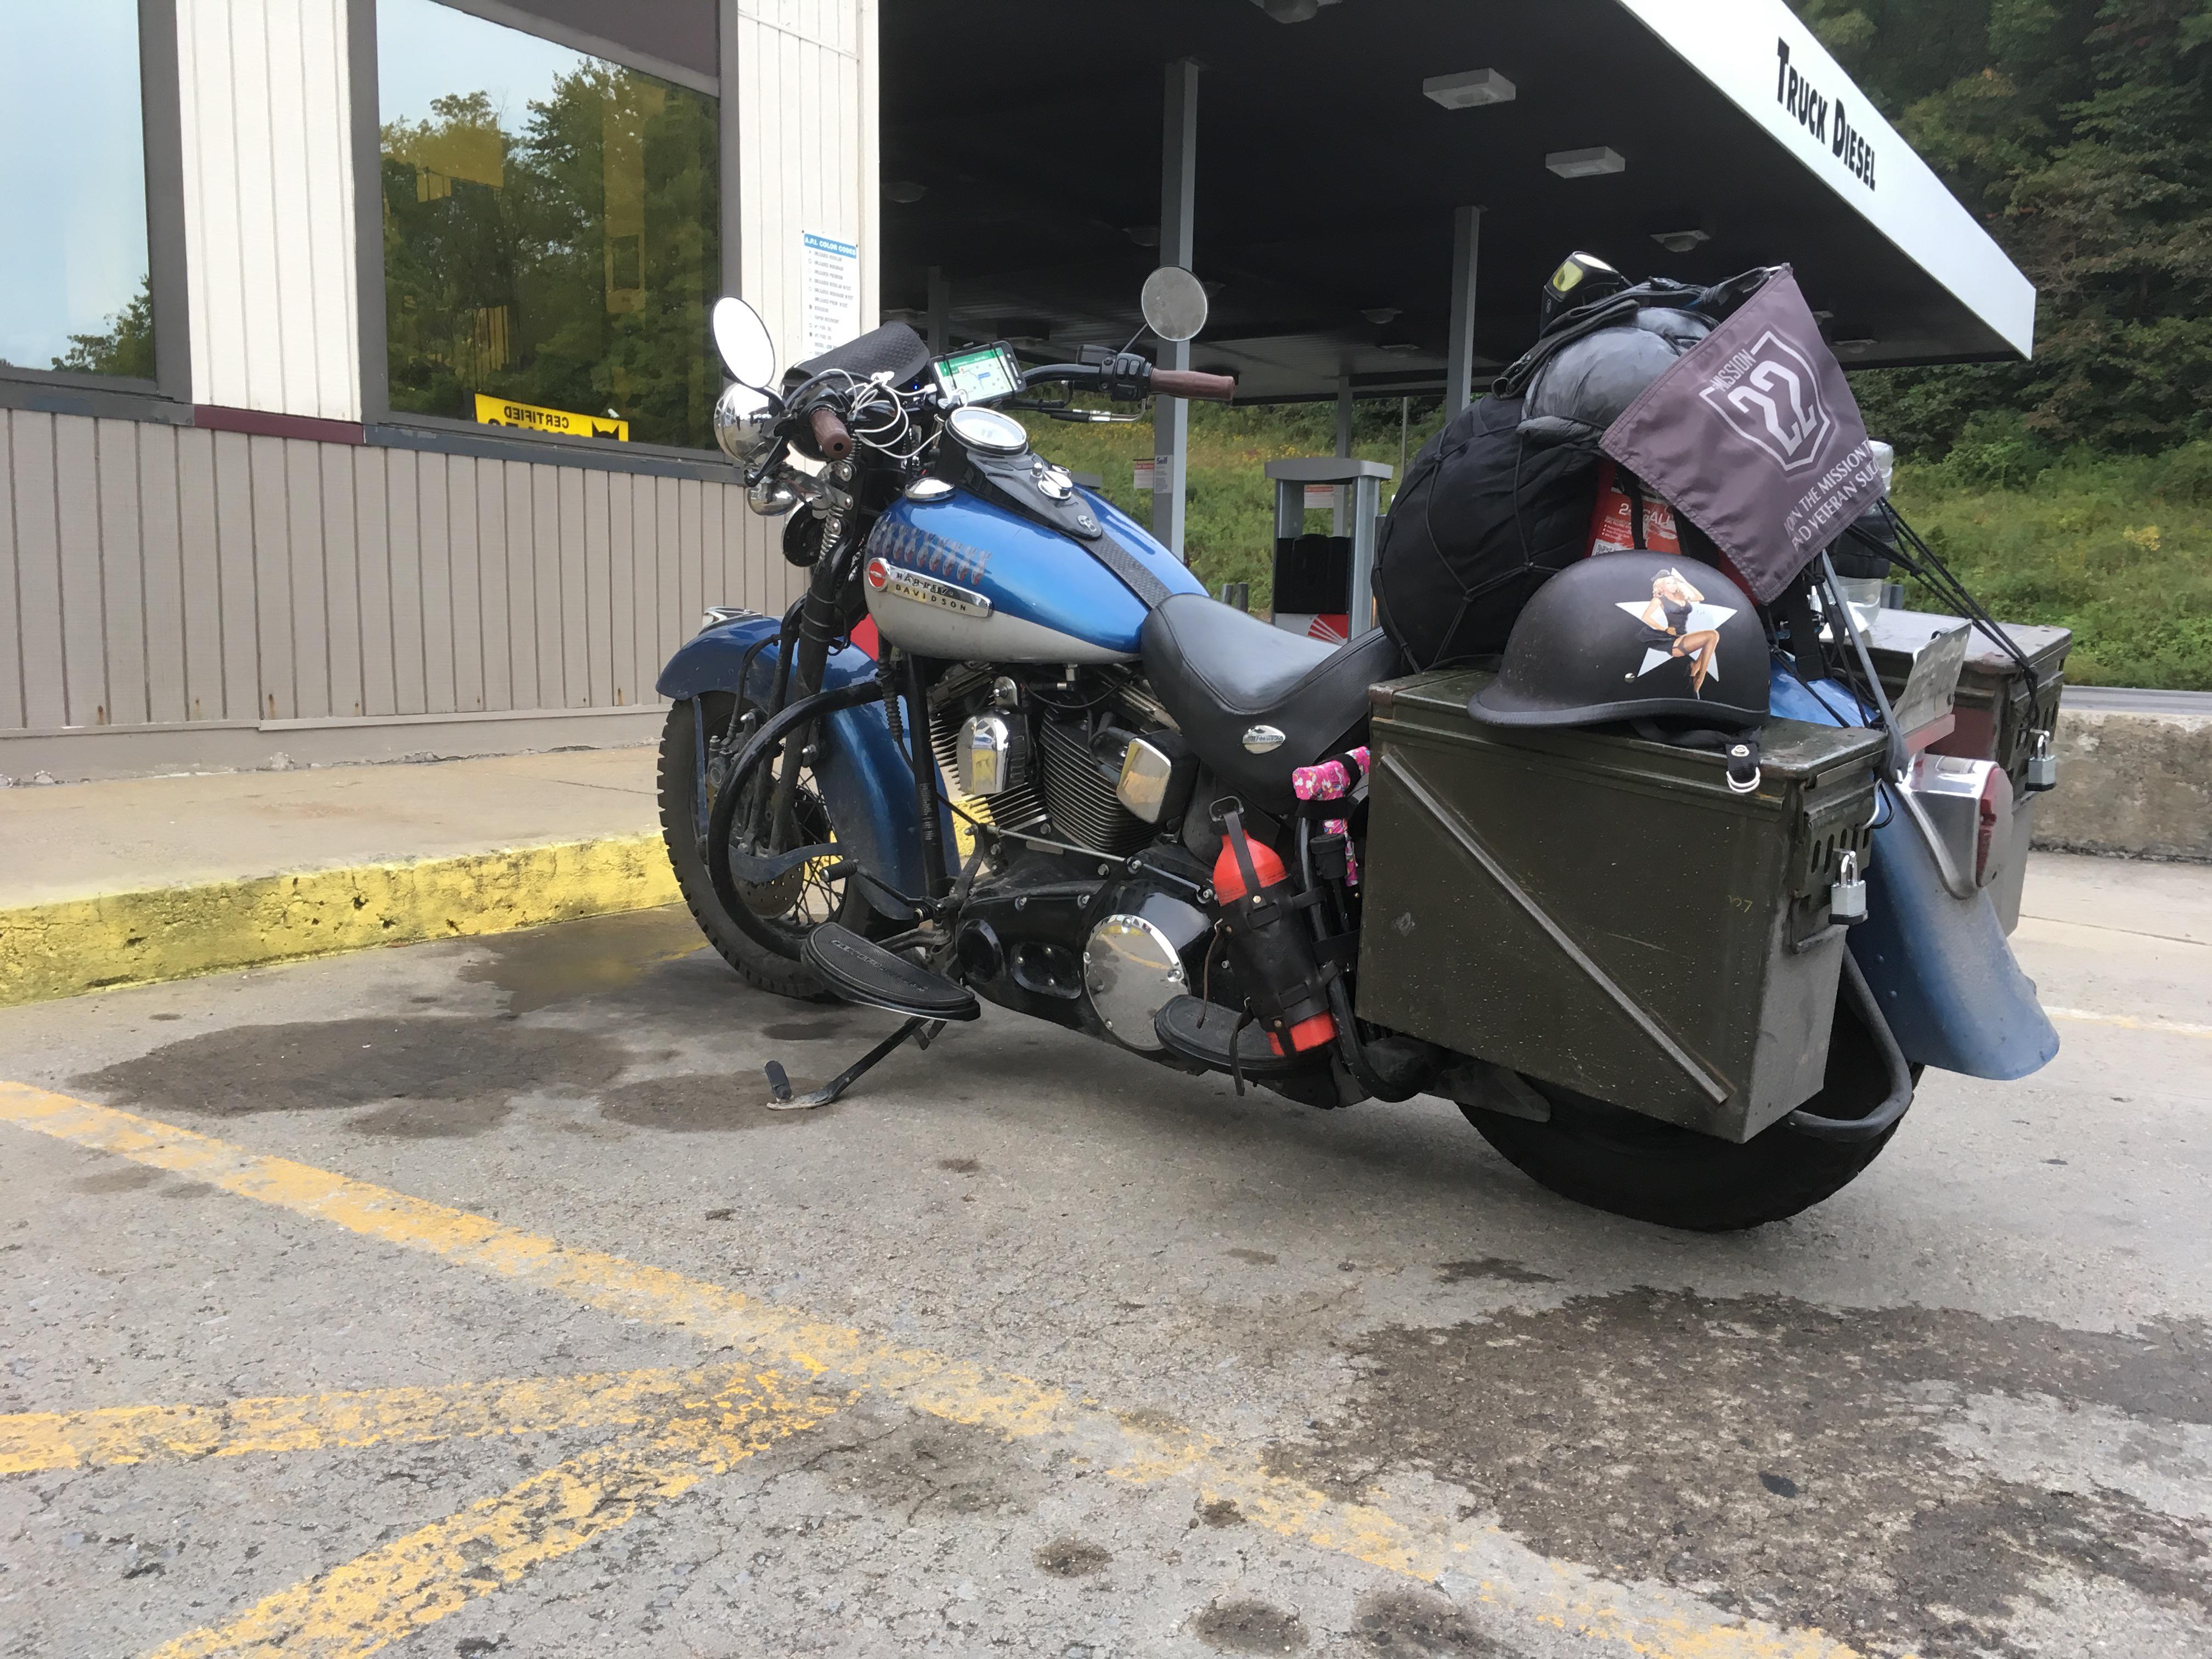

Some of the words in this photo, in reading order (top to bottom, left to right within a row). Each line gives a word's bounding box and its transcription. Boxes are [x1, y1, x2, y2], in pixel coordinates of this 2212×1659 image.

[819, 240, 838, 251] COLOR
[838, 245, 856, 256] CODES
[1709, 348, 1757, 392] MISSION
[1728, 360, 1818, 457] 22
[1156, 456, 1169, 465] Self
[1798, 487, 1821, 511] THE
[1817, 446, 1864, 494] MISSION
[1808, 481, 1858, 530] VETERAN
[895, 584, 967, 611] DAVIDSON
